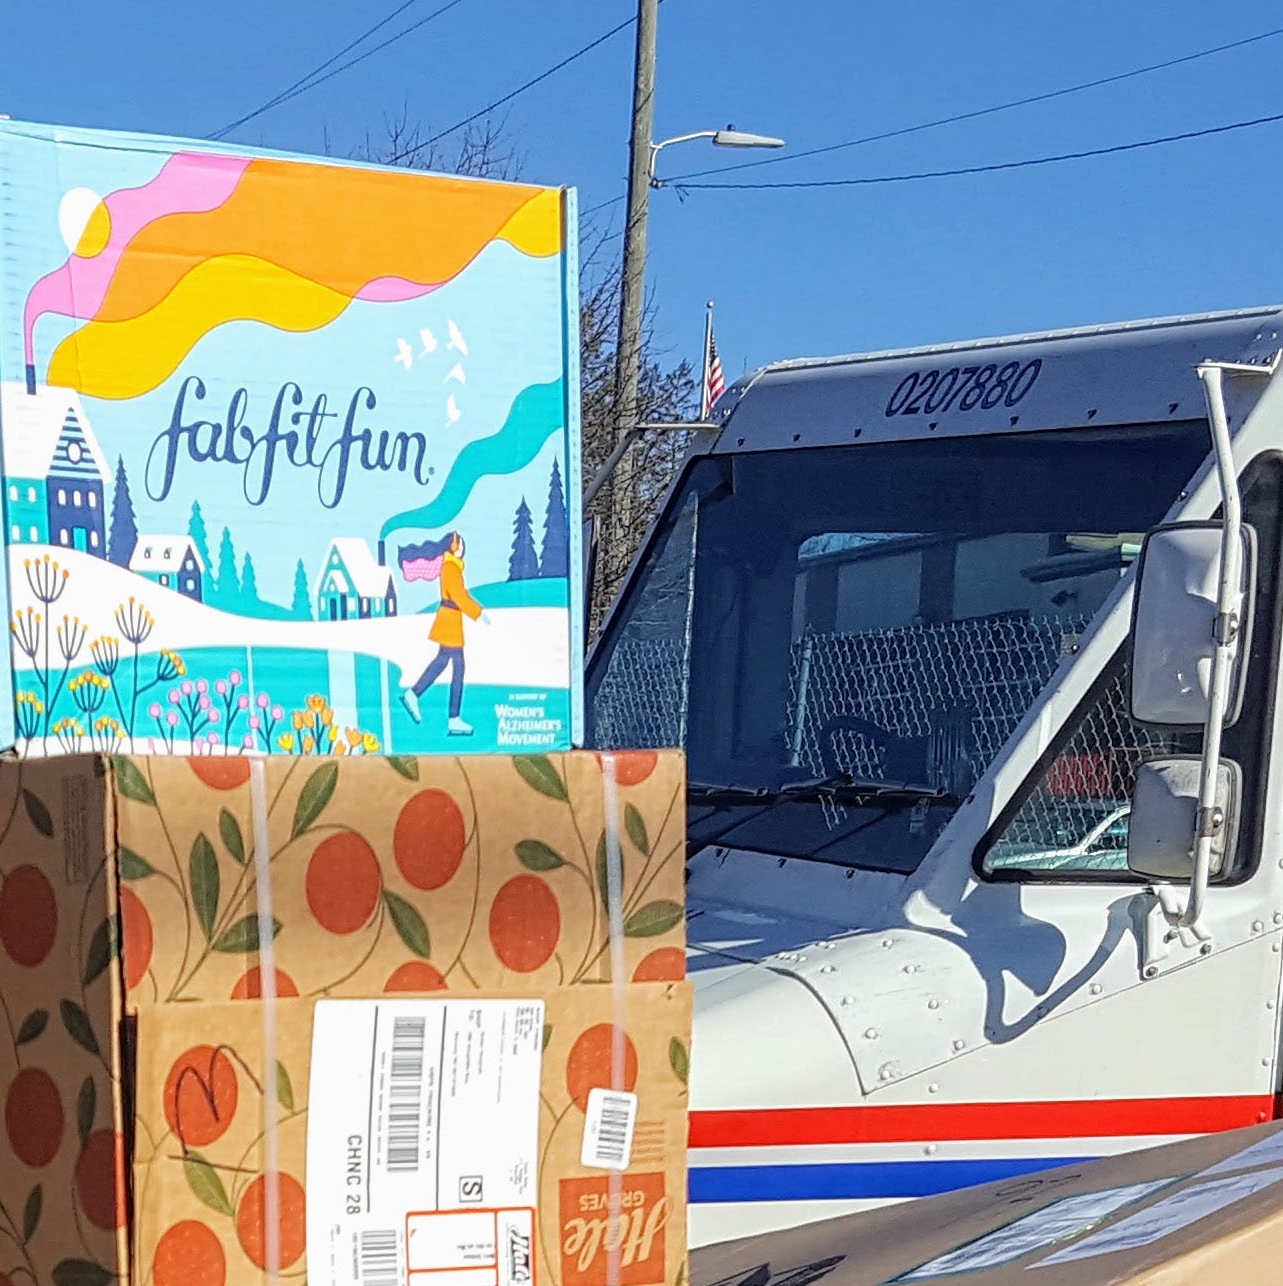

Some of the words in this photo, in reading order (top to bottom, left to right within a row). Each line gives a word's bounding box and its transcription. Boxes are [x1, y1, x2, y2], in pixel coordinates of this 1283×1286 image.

[885, 358, 1043, 417] 0207880
[345, 1134, 363, 1187] CHNC
[345, 1193, 361, 1215] 28
[562, 1196, 671, 1273] Hale
